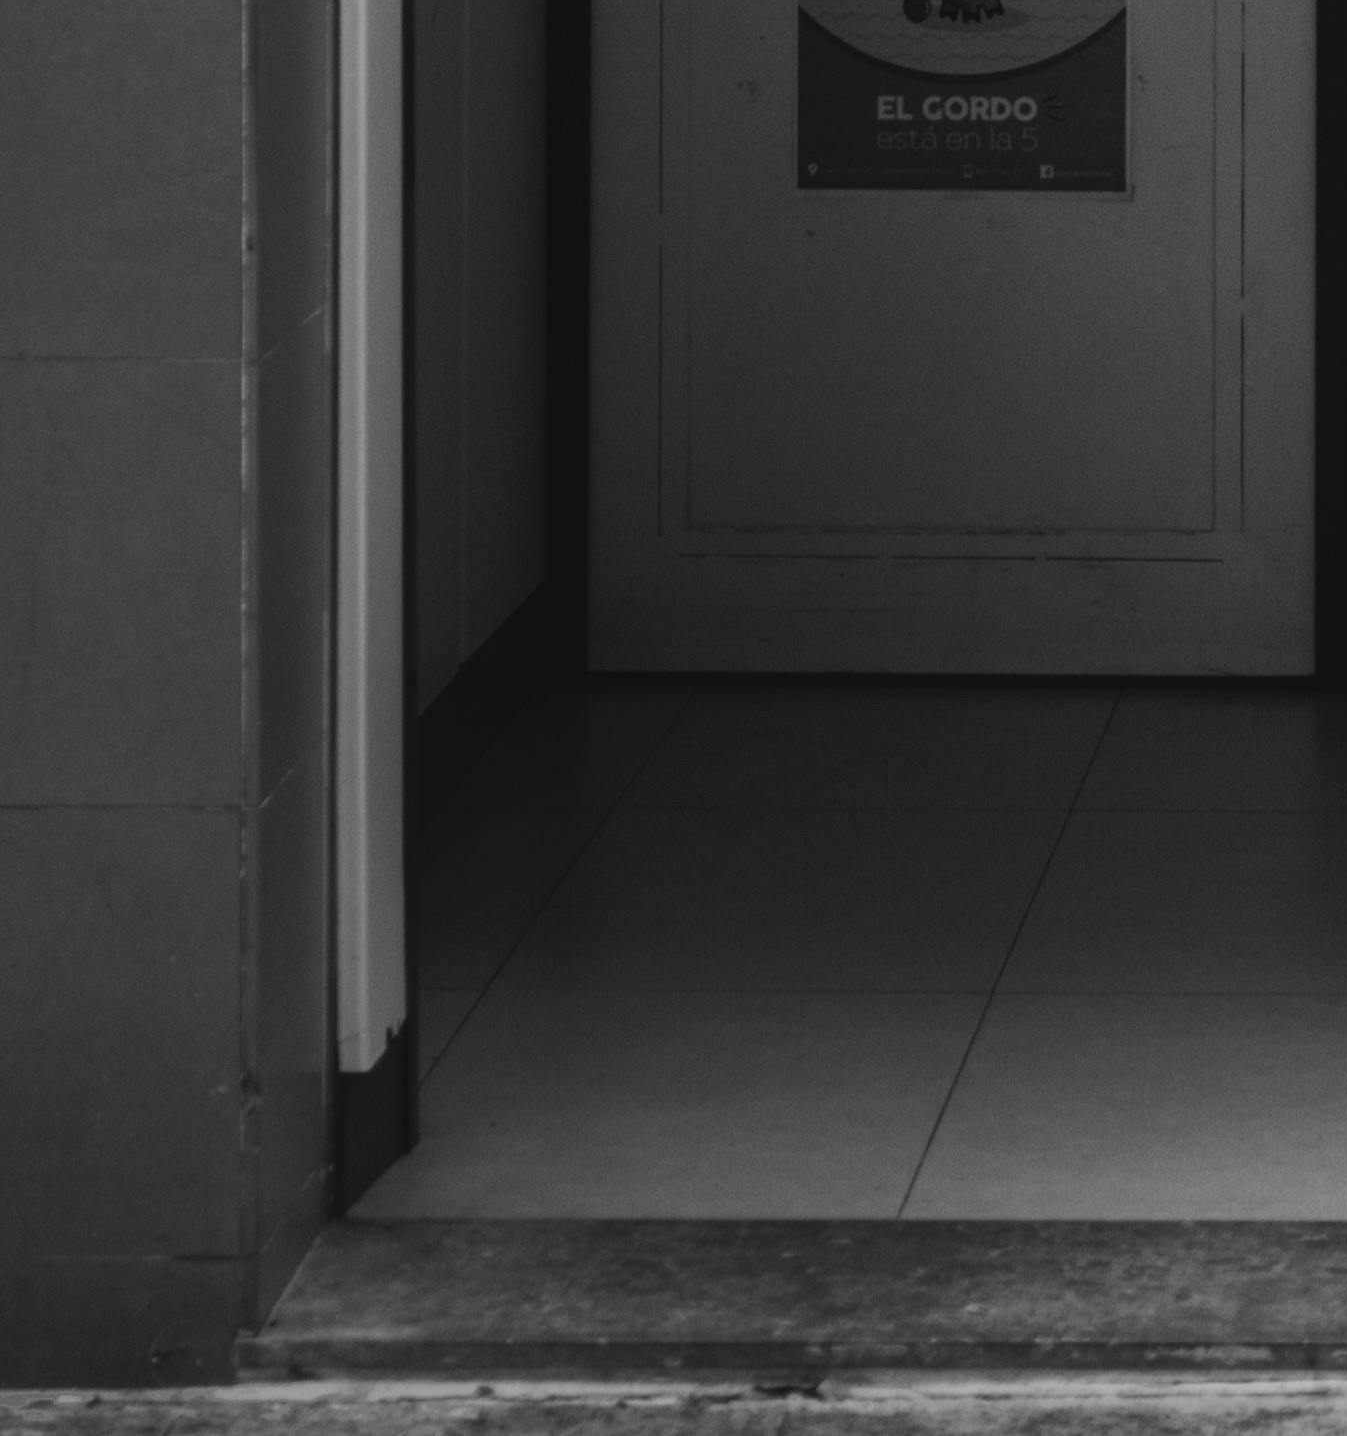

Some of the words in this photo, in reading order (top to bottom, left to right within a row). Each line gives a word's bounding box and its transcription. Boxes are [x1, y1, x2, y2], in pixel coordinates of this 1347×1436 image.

[876, 95, 914, 121] EL
[921, 95, 1040, 123] GORDO
[876, 125, 938, 152] está
[945, 130, 982, 152] en
[990, 125, 1013, 152] la
[1020, 125, 1040, 154] 5
